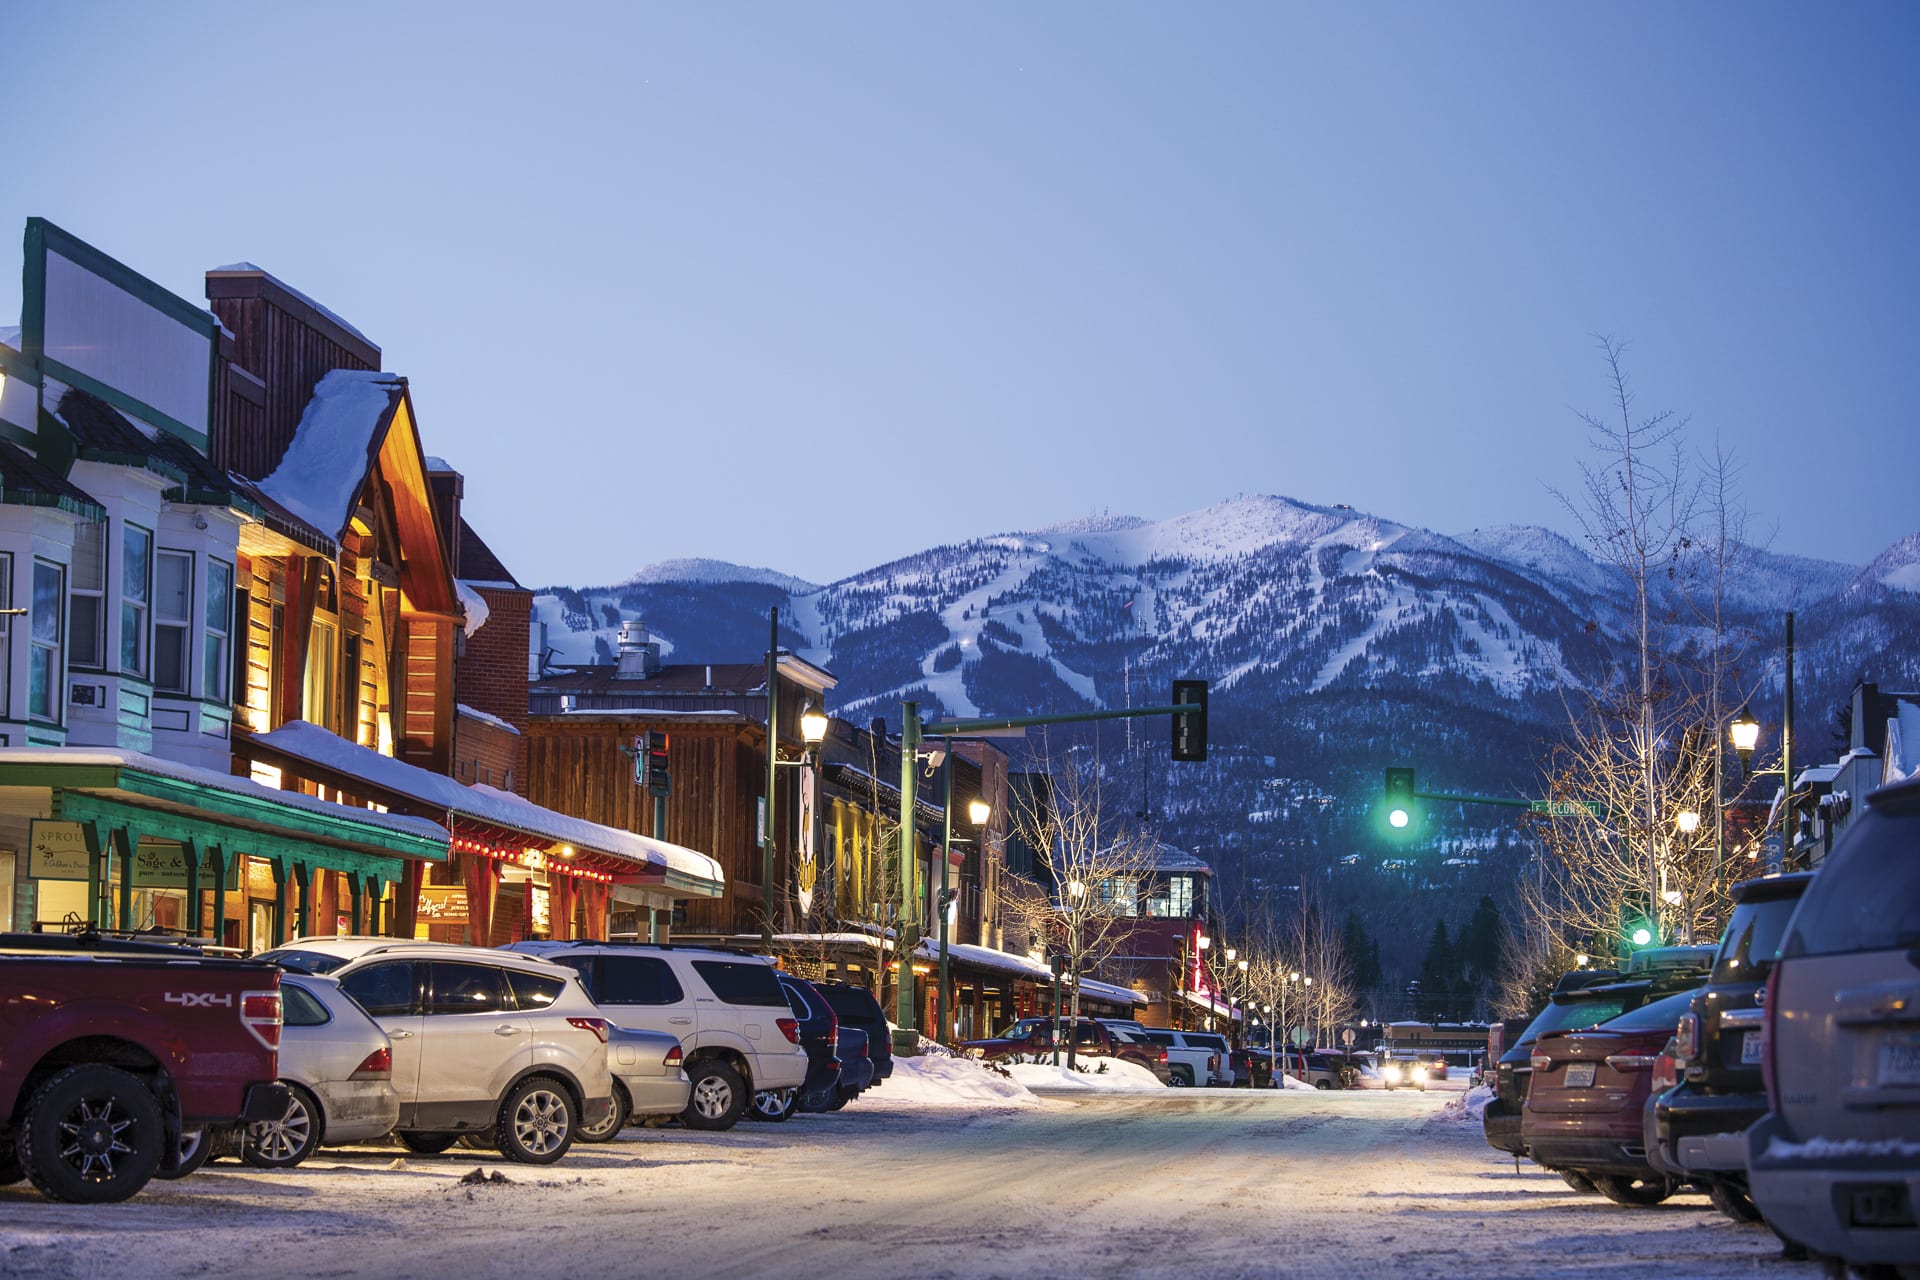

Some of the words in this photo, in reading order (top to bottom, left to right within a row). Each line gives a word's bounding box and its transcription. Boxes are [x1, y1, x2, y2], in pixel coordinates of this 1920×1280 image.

[40, 831, 82, 842] SPROU
[137, 854, 165, 869] Sage
[170, 855, 182, 868] &
